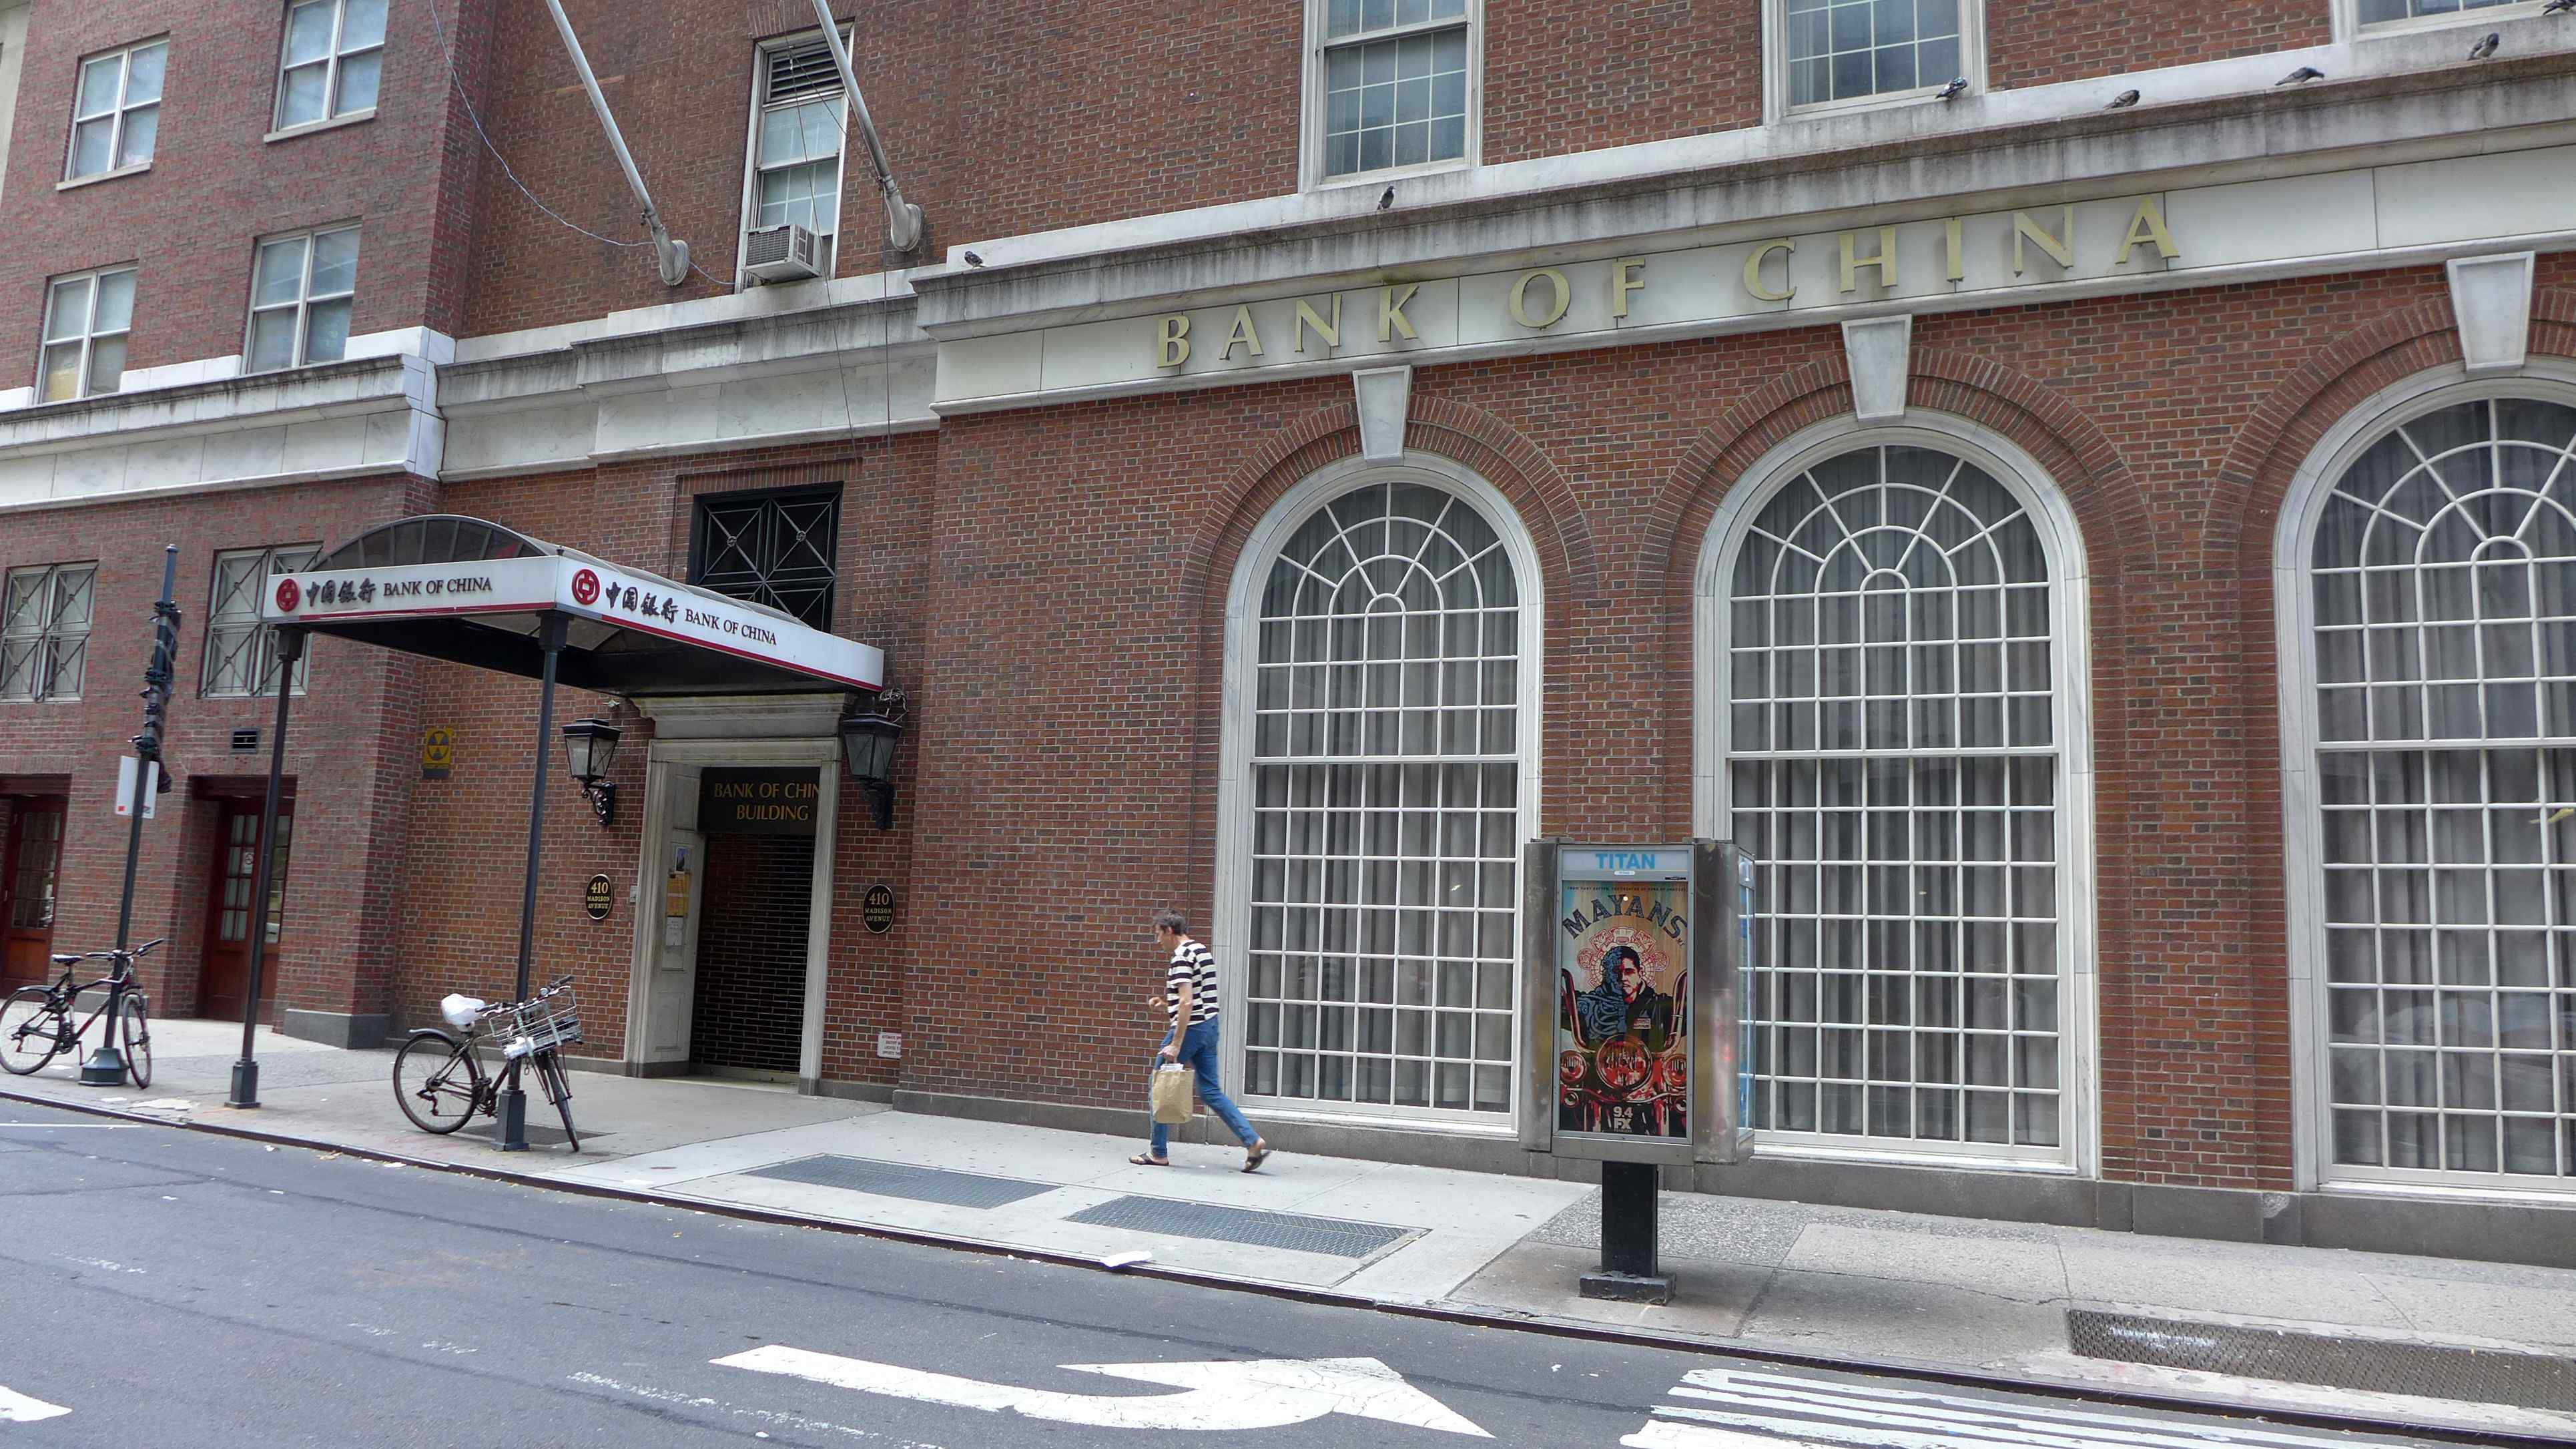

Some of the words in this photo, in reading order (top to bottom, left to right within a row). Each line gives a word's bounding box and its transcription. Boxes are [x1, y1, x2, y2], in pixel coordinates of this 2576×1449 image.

[1157, 285, 1420, 369] BANK
[1509, 257, 1646, 329] OF
[1742, 200, 2180, 302] CHINA
[384, 581, 421, 597] BANK
[426, 579, 444, 594] OF
[447, 577, 492, 593] CHINA
[685, 608, 719, 630] BANK
[723, 619, 739, 635] OF
[741, 624, 777, 645] CHINA
[715, 783, 755, 798] BANK
[759, 783, 780, 798] OF
[784, 783, 820, 798] CHIN
[736, 805, 809, 821] BUILDING
[1596, 854, 1656, 869] TITAN
[591, 882, 609, 894] 410
[869, 892, 890, 905] 410
[1562, 894, 1688, 939] MAYANS
[1613, 1106, 1634, 1118] 9.4
[1614, 1118, 1632, 1129] FX
